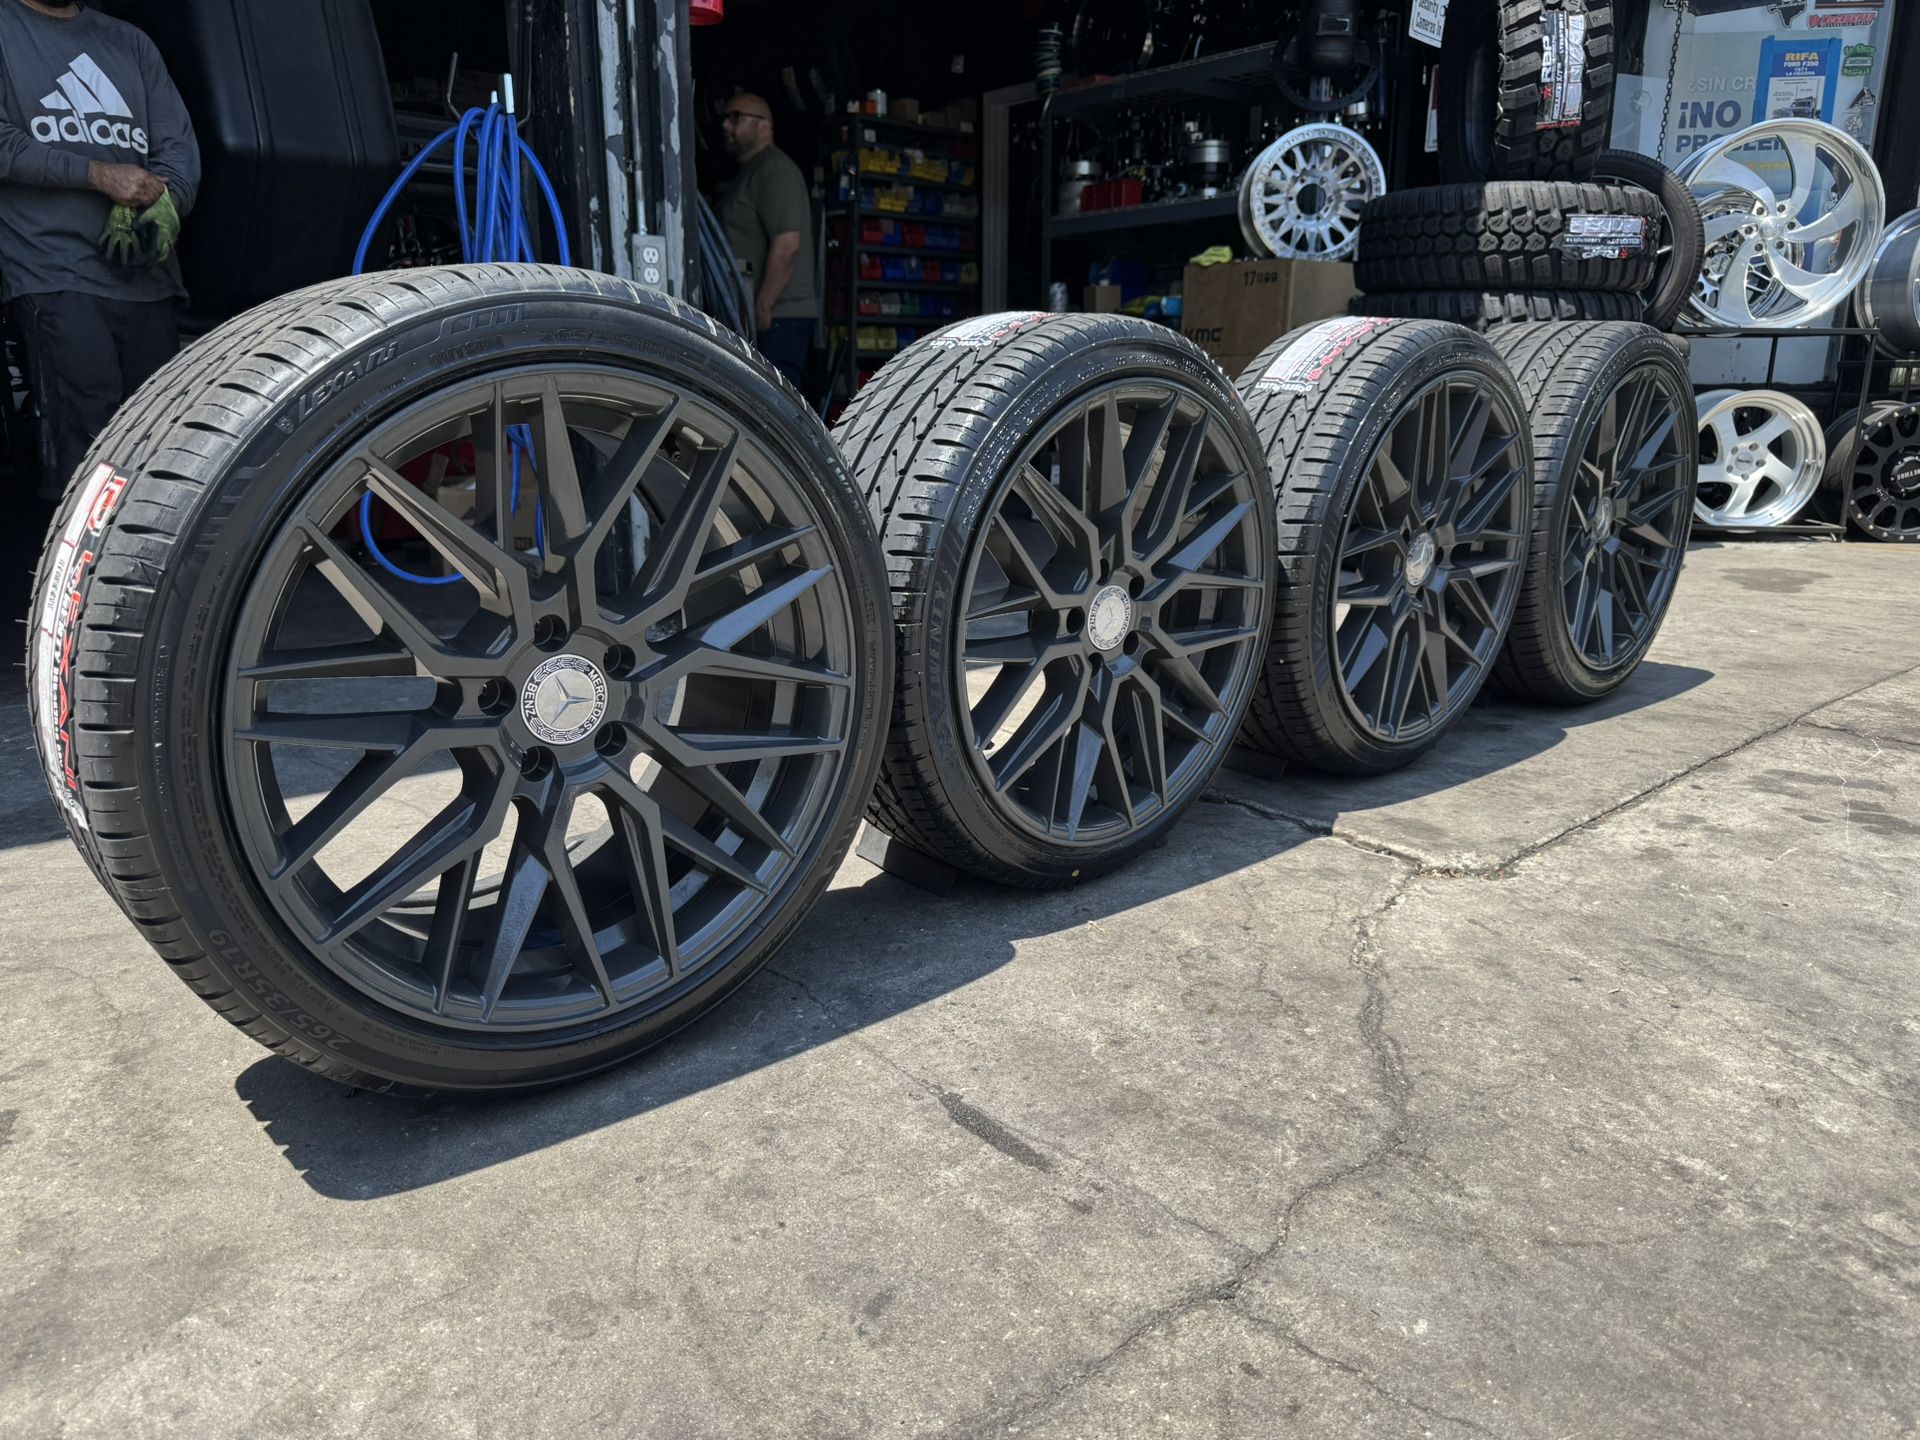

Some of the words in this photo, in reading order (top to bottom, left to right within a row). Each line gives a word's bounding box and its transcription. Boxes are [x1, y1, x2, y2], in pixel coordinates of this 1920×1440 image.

[1415, 11, 1436, 35] Cameras
[1541, 35, 1552, 83] RBP
[1785, 52, 1819, 61] RIFA
[1687, 77, 1726, 92] ¿SIN
[30, 108, 149, 154] adidas
[1678, 99, 1742, 129] ¡NO
[58, 549, 94, 791] LEXANI
[523, 682, 538, 718] BENZ
[587, 668, 606, 731] MERCEDES
